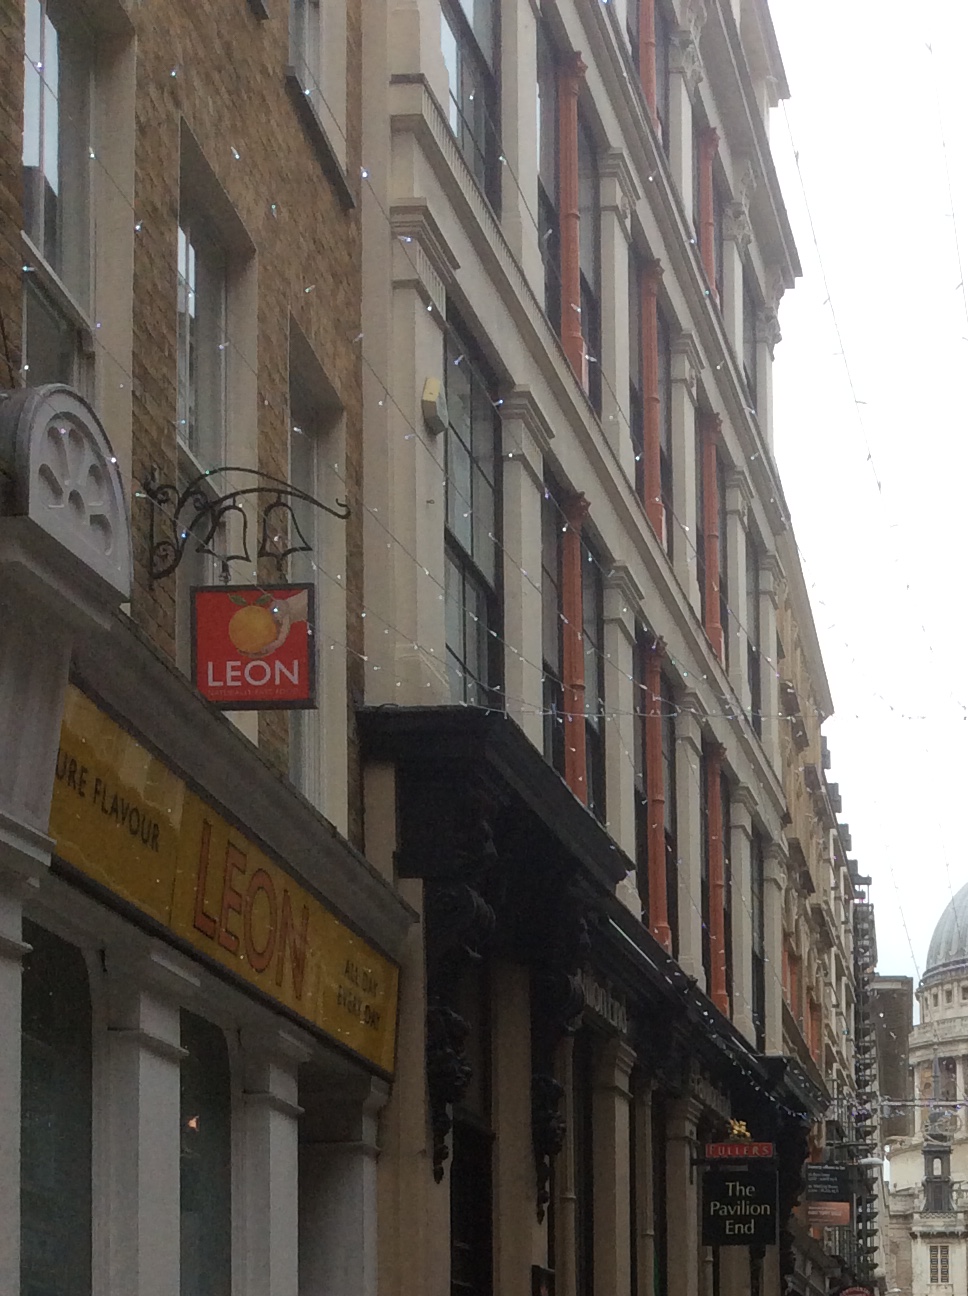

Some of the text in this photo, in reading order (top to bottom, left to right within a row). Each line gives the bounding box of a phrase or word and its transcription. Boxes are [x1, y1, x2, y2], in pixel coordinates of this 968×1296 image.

[207, 660, 299, 687] LEON
[93, 777, 160, 853] FLAVOUR
[193, 818, 310, 1000] LEON
[725, 1181, 756, 1197] The
[710, 1199, 771, 1216] Pavilion
[725, 1218, 755, 1235] End
